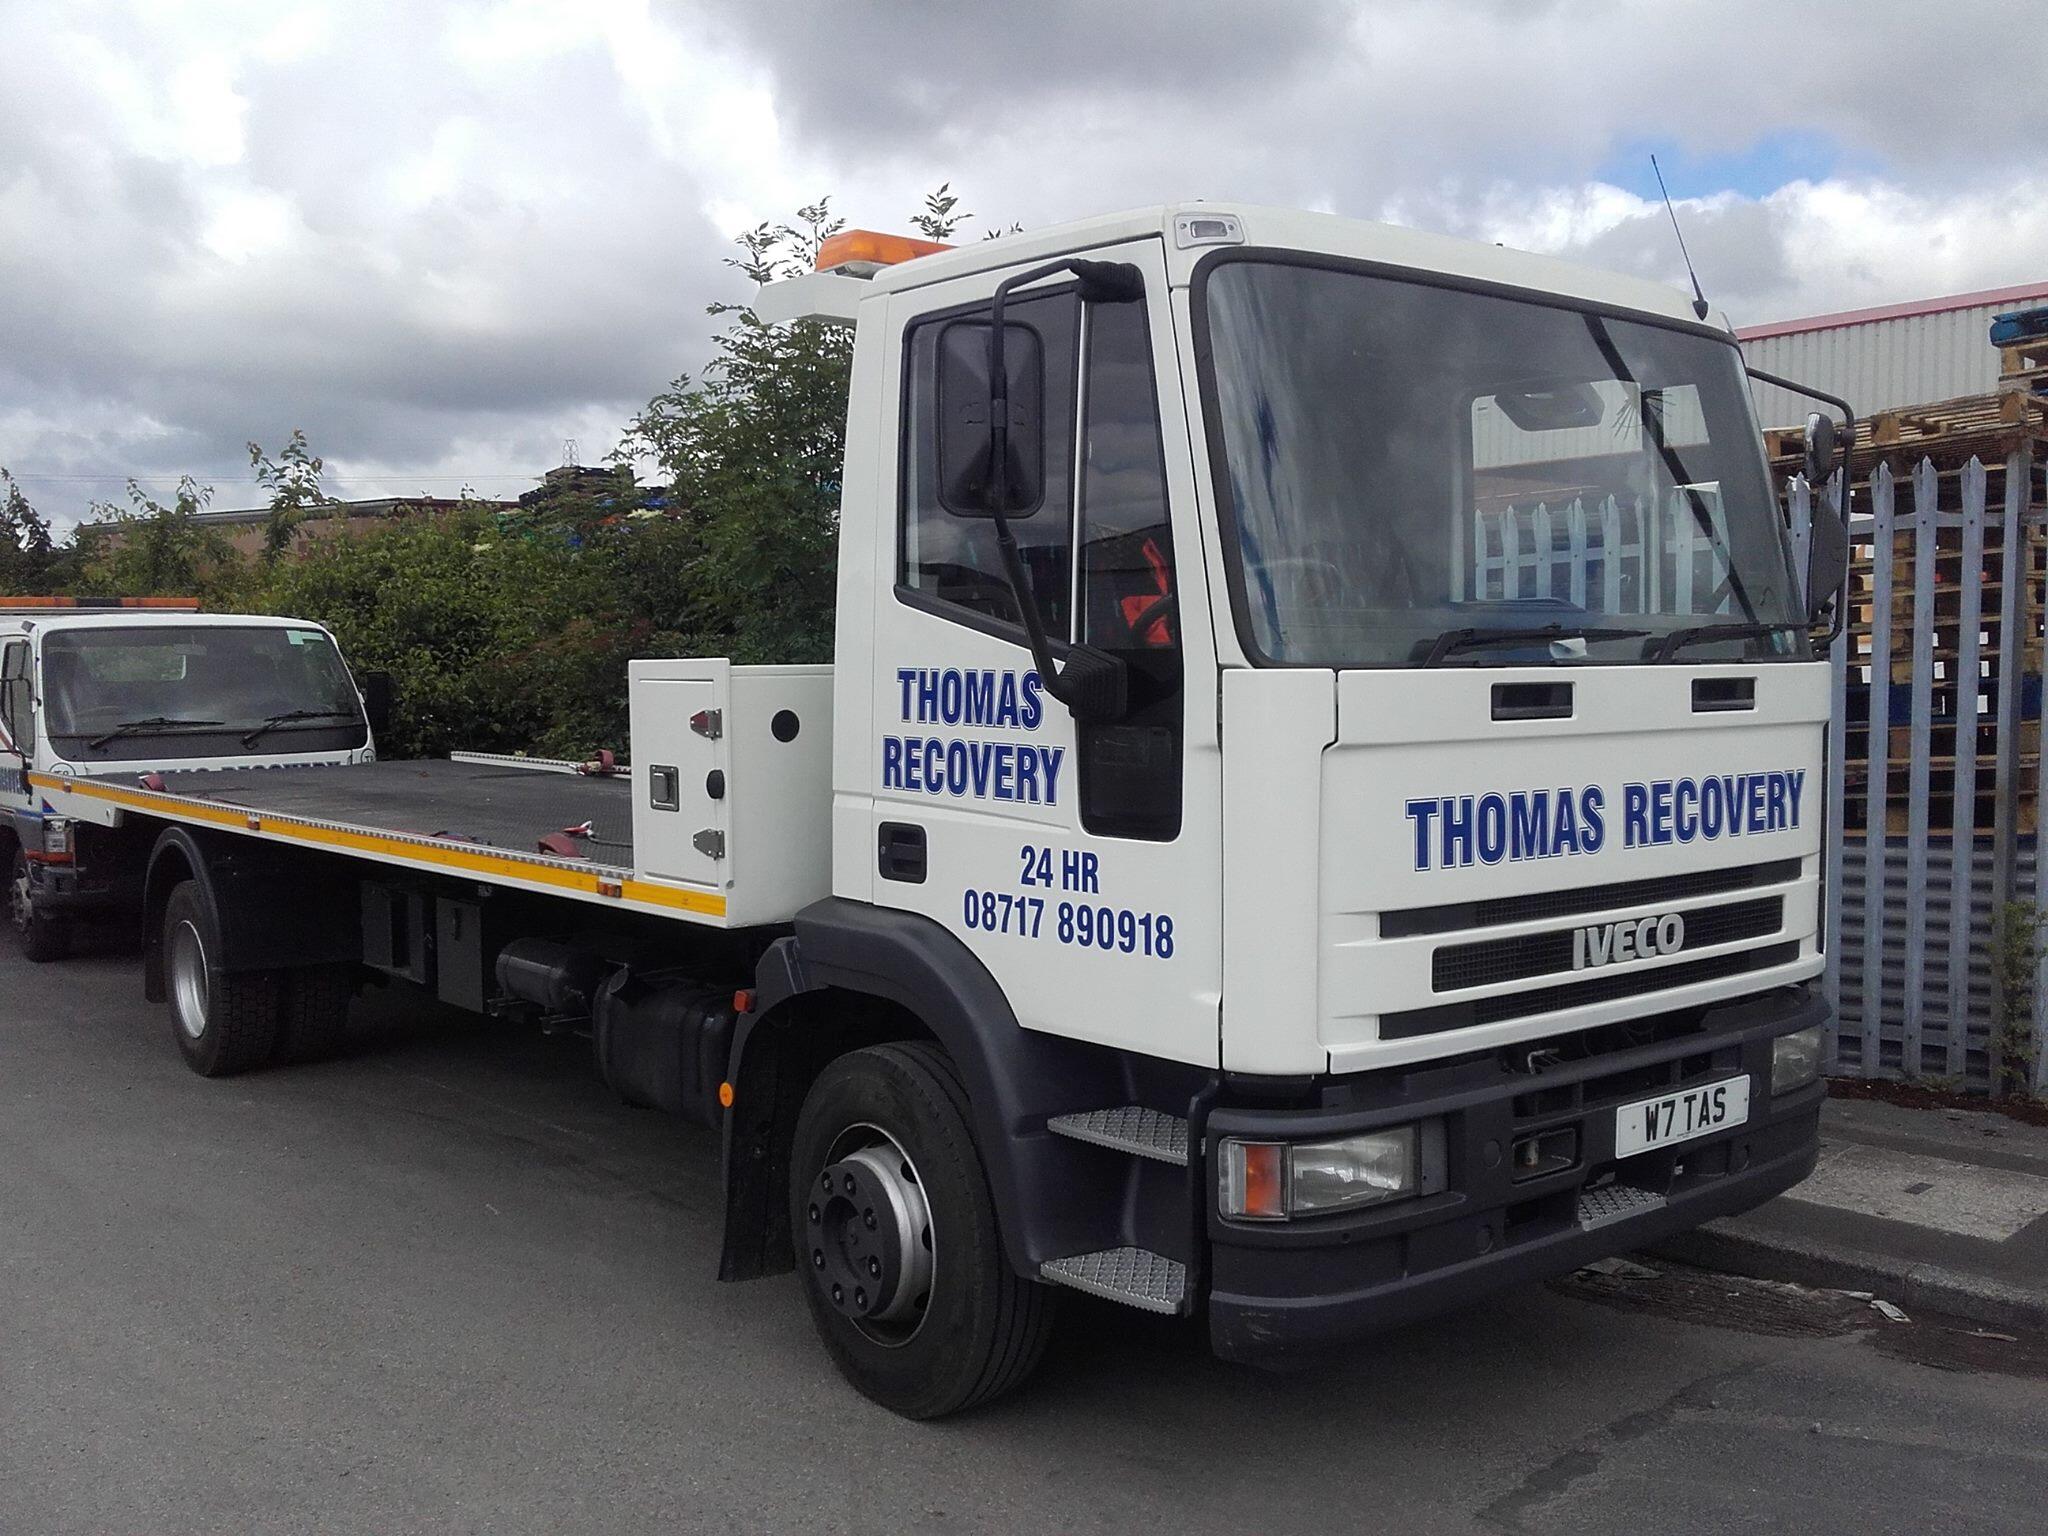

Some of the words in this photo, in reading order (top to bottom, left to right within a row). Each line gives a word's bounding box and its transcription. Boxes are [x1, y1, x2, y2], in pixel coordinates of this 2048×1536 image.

[896, 667, 1044, 731] THOMAS
[882, 735, 1066, 806] RECOVERY
[1405, 785, 1605, 872] THOMAS
[1623, 769, 1806, 850] RECOVERY
[1020, 845, 1053, 888] 24
[1061, 849, 1099, 894] HR
[963, 888, 1045, 938] 08717
[1057, 901, 1174, 959] 890918
[1572, 913, 1685, 970] IVECO
[1645, 1099, 1676, 1142] W7
[1683, 1086, 1726, 1131] TAS
